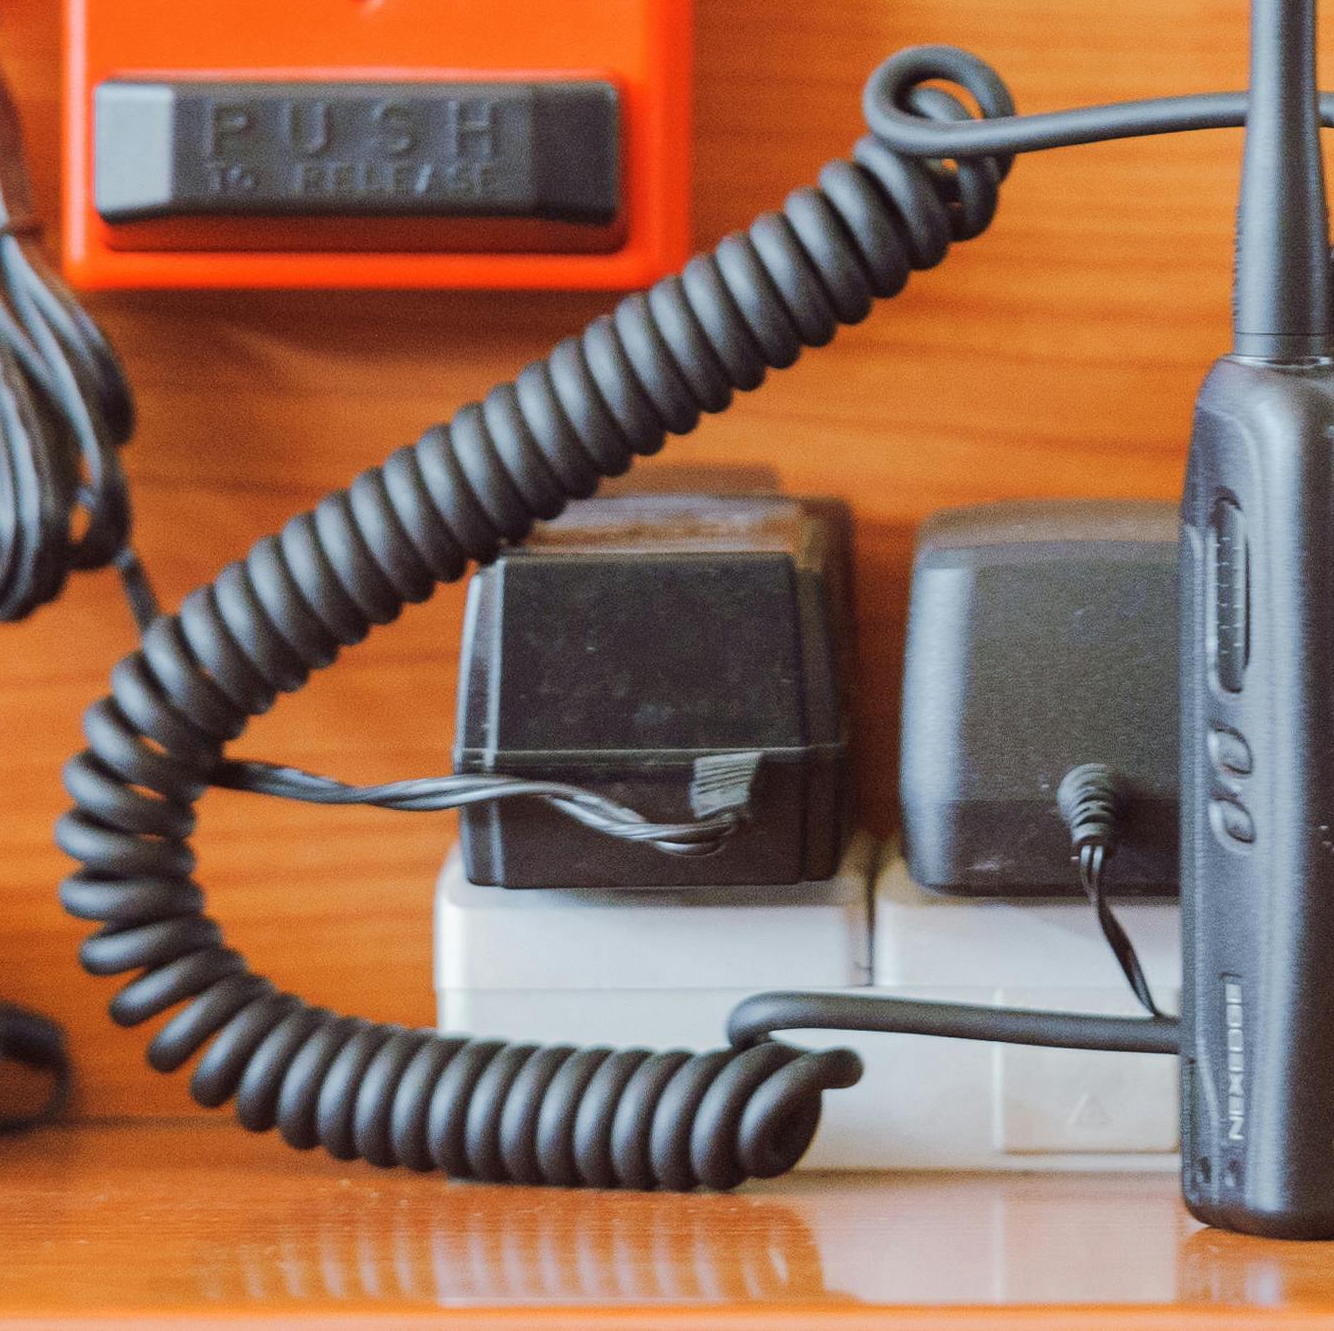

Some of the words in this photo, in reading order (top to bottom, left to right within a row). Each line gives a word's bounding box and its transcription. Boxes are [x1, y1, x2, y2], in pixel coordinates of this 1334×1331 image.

[201, 99, 503, 160] PUSH
[203, 160, 259, 195] TO
[290, 160, 501, 197] RELEASE
[1225, 983, 1245, 1141] NEXEDGE
